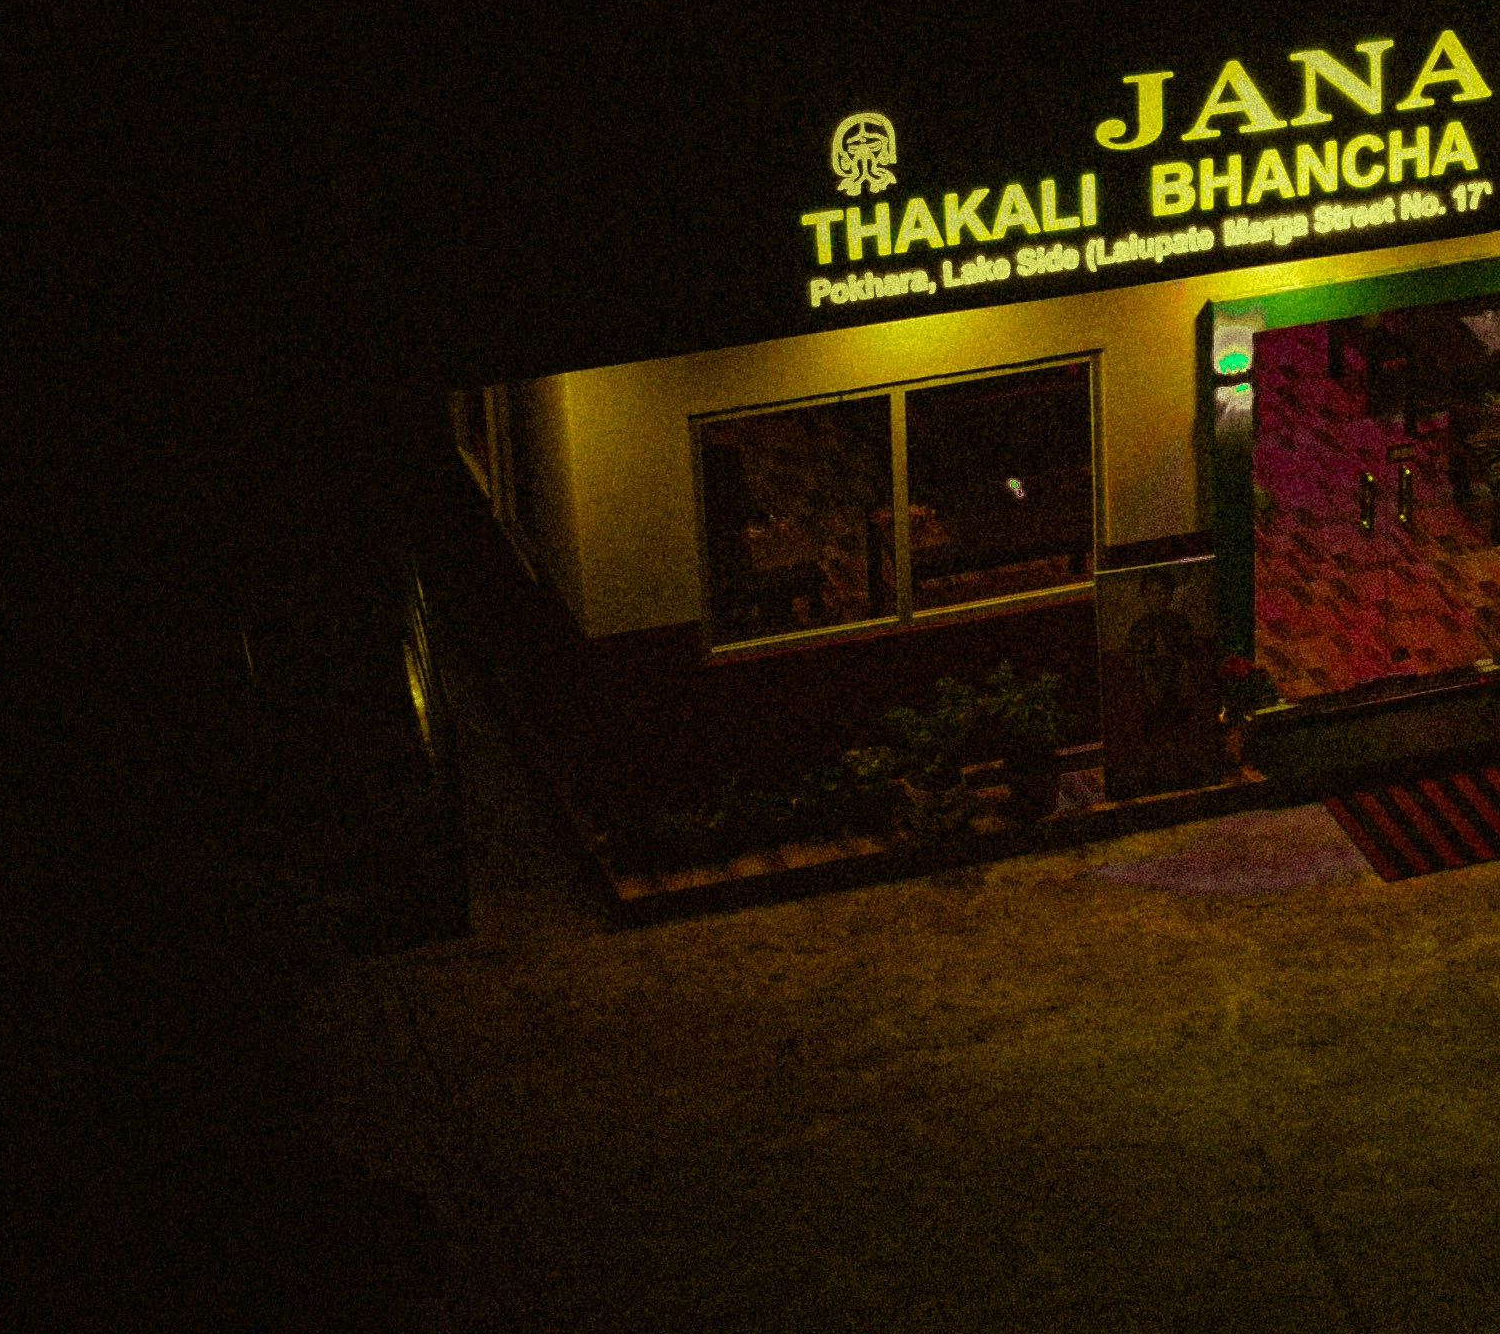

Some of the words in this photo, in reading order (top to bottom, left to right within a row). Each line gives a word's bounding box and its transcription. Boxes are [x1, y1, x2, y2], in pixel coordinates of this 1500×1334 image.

[800, 172, 1098, 265] THAKALI
[1150, 120, 1479, 218] BHANCHA
[809, 268, 938, 308] Pokhara,
[941, 253, 1011, 289] Lake
[1015, 241, 1080, 278] Side
[1313, 196, 1396, 235] Street
[1400, 189, 1447, 221] No.
